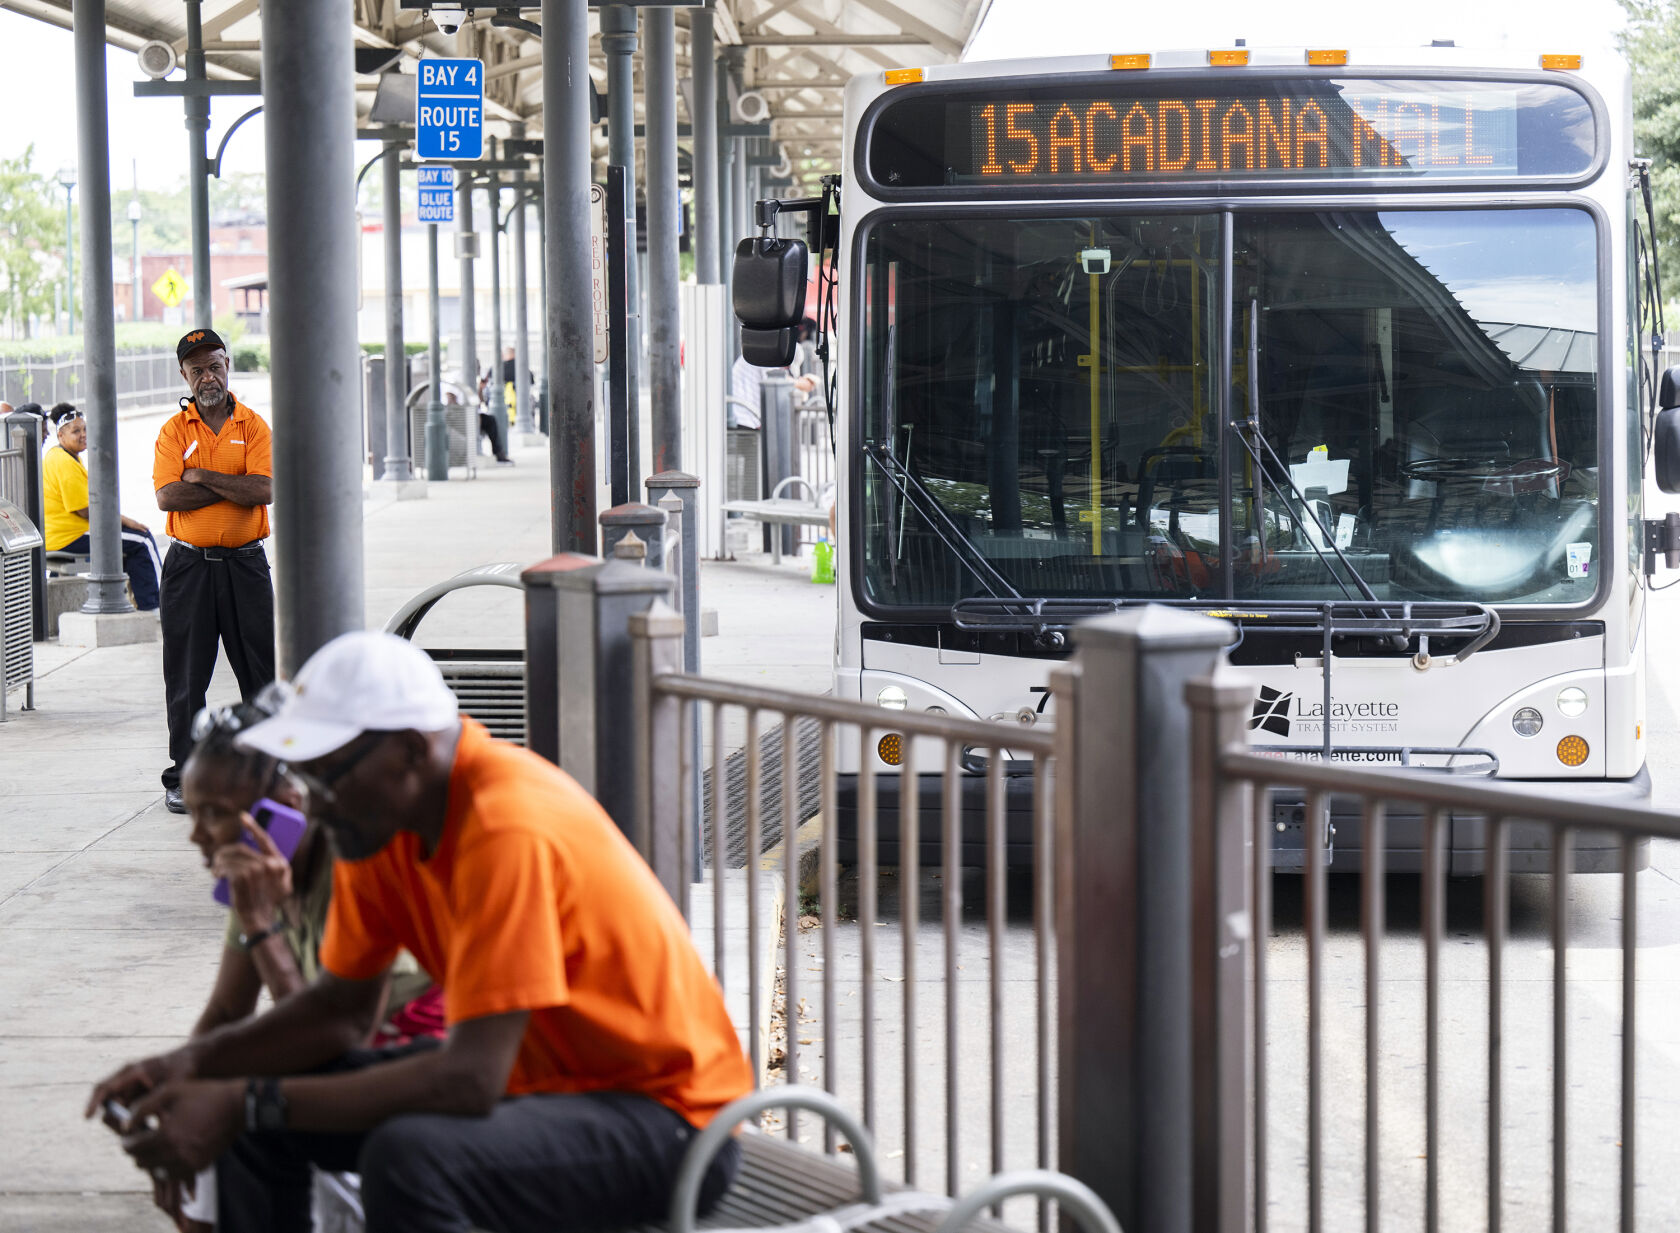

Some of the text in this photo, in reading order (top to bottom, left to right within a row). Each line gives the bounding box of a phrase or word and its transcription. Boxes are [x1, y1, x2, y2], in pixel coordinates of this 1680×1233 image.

[423, 65, 477, 87] BAY 4
[420, 106, 480, 127] ROUTE
[439, 130, 461, 152] 15
[981, 95, 1493, 174] 15 ACADIANA MALL
[418, 169, 453, 183] BAY 10
[420, 192, 451, 206] BLUE
[419, 206, 453, 220] ROUTE
[591, 235, 603, 336] RED ROUTE
[1296, 723, 1398, 732] TRASIT SYSTEM
